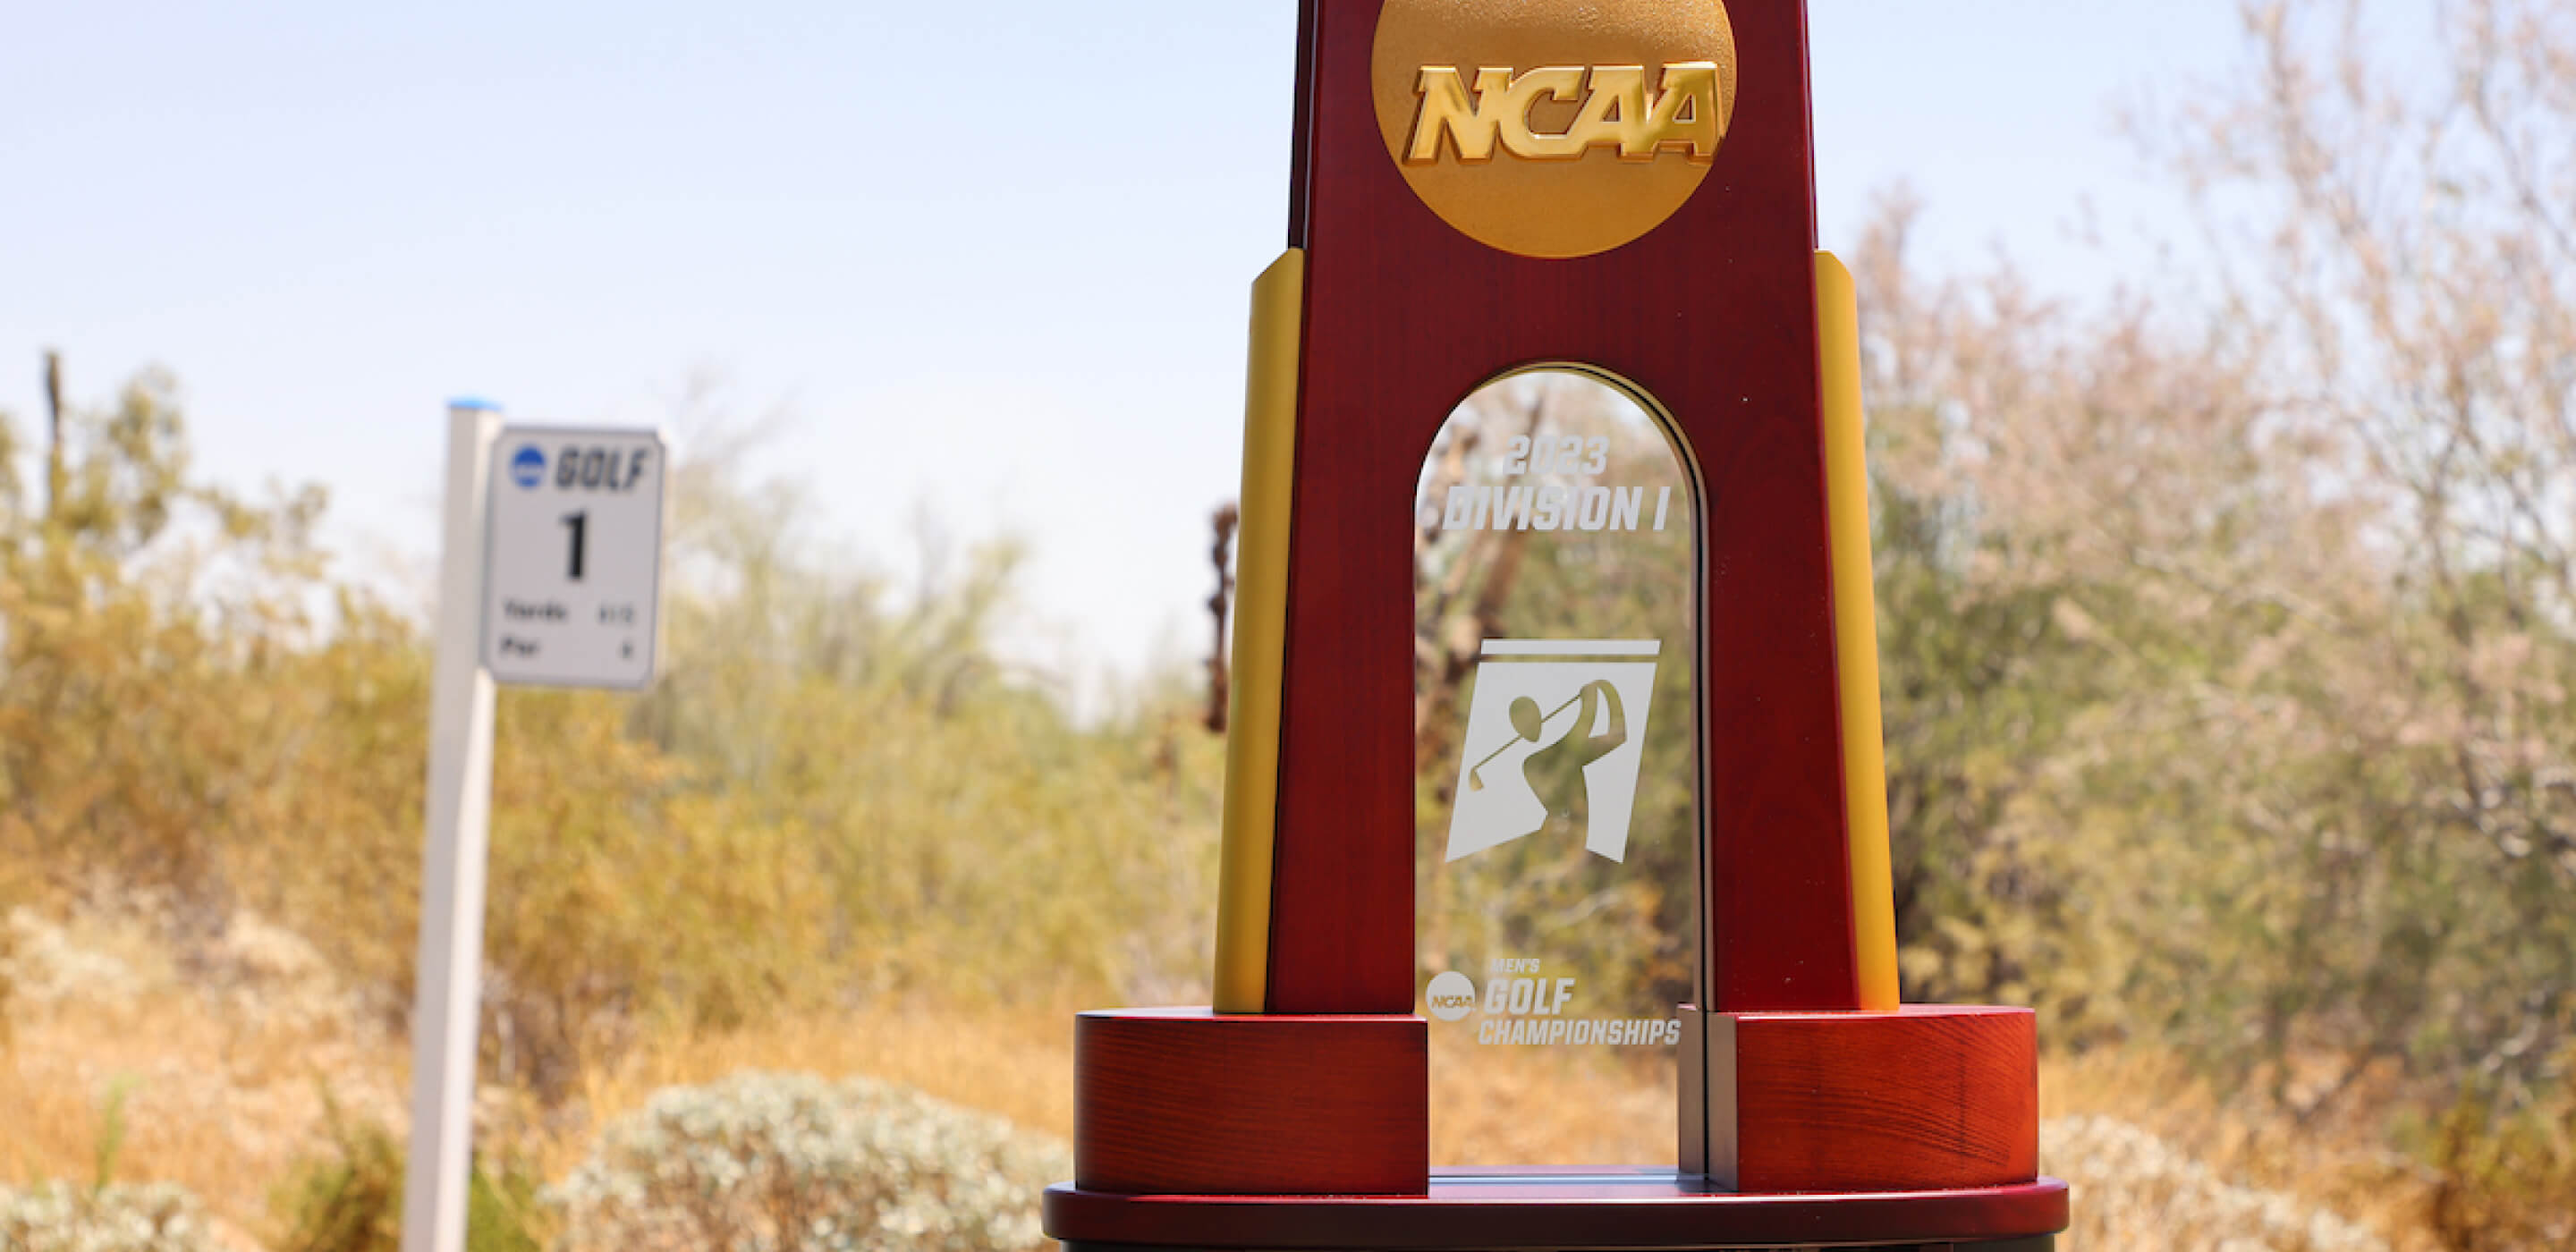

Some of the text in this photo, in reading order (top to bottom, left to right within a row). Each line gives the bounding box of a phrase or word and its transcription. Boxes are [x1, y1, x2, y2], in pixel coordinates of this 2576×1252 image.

[1404, 62, 1721, 163] NCAA
[555, 447, 648, 490] GOLF
[1503, 435, 1609, 475] 2023
[1442, 486, 1671, 530] DIVISION I
[558, 507, 587, 580] 1
[1491, 958, 1540, 973] MEN'S
[1484, 977, 1575, 1015] GOLF
[1479, 1019, 1682, 1045] CHAMPIONSHIPS
